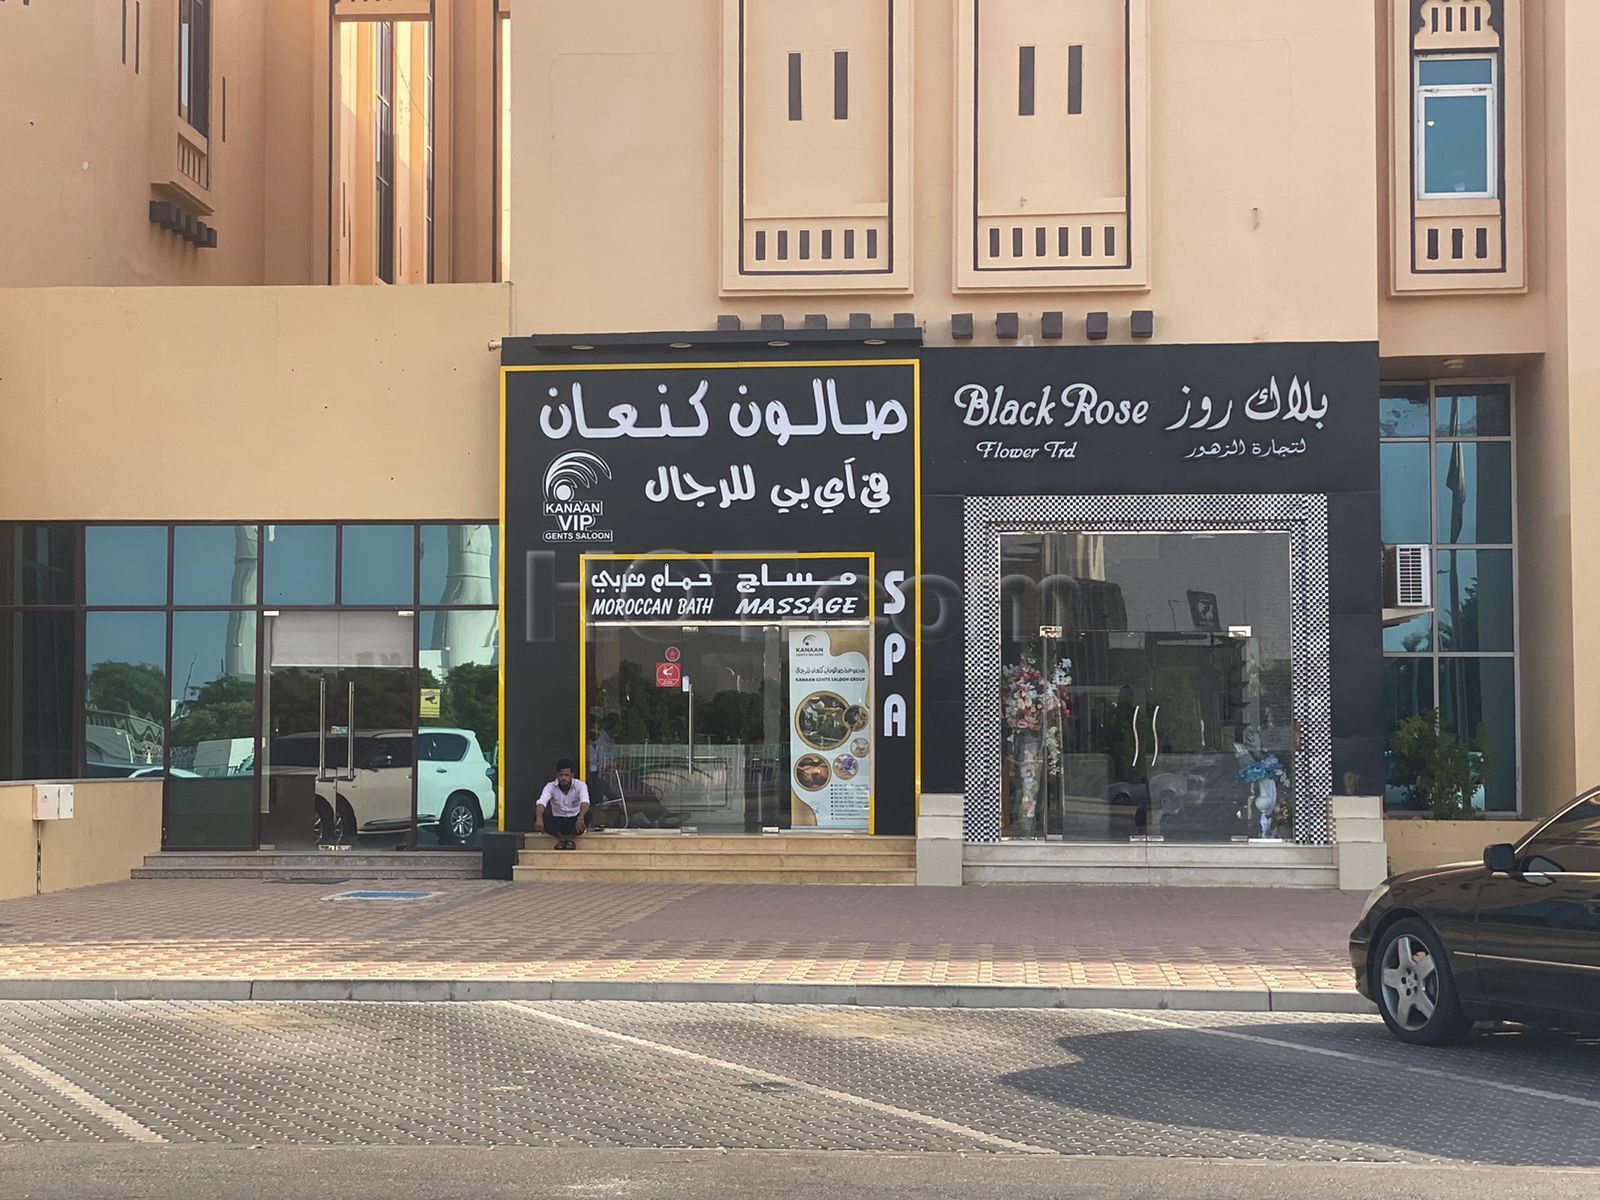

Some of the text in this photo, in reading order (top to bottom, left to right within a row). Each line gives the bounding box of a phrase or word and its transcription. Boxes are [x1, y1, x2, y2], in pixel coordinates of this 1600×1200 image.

[539, 378, 908, 446] صالون كنعان
[953, 382, 1149, 428] Black Rose
[1164, 374, 1329, 431] بلاك روز
[976, 440, 1078, 459] Flower Trd
[1183, 437, 1307, 459] لتجارة الزهور
[644, 463, 757, 509] للرجال
[545, 502, 600, 514] KANAAN
[558, 514, 593, 532] VIP
[545, 532, 610, 540] GENTS SALOON
[591, 563, 713, 593] حمام مغربي
[736, 563, 857, 593] مساج
[591, 598, 714, 616] MOROCCAN BATH
[734, 597, 859, 615] MASSAGE
